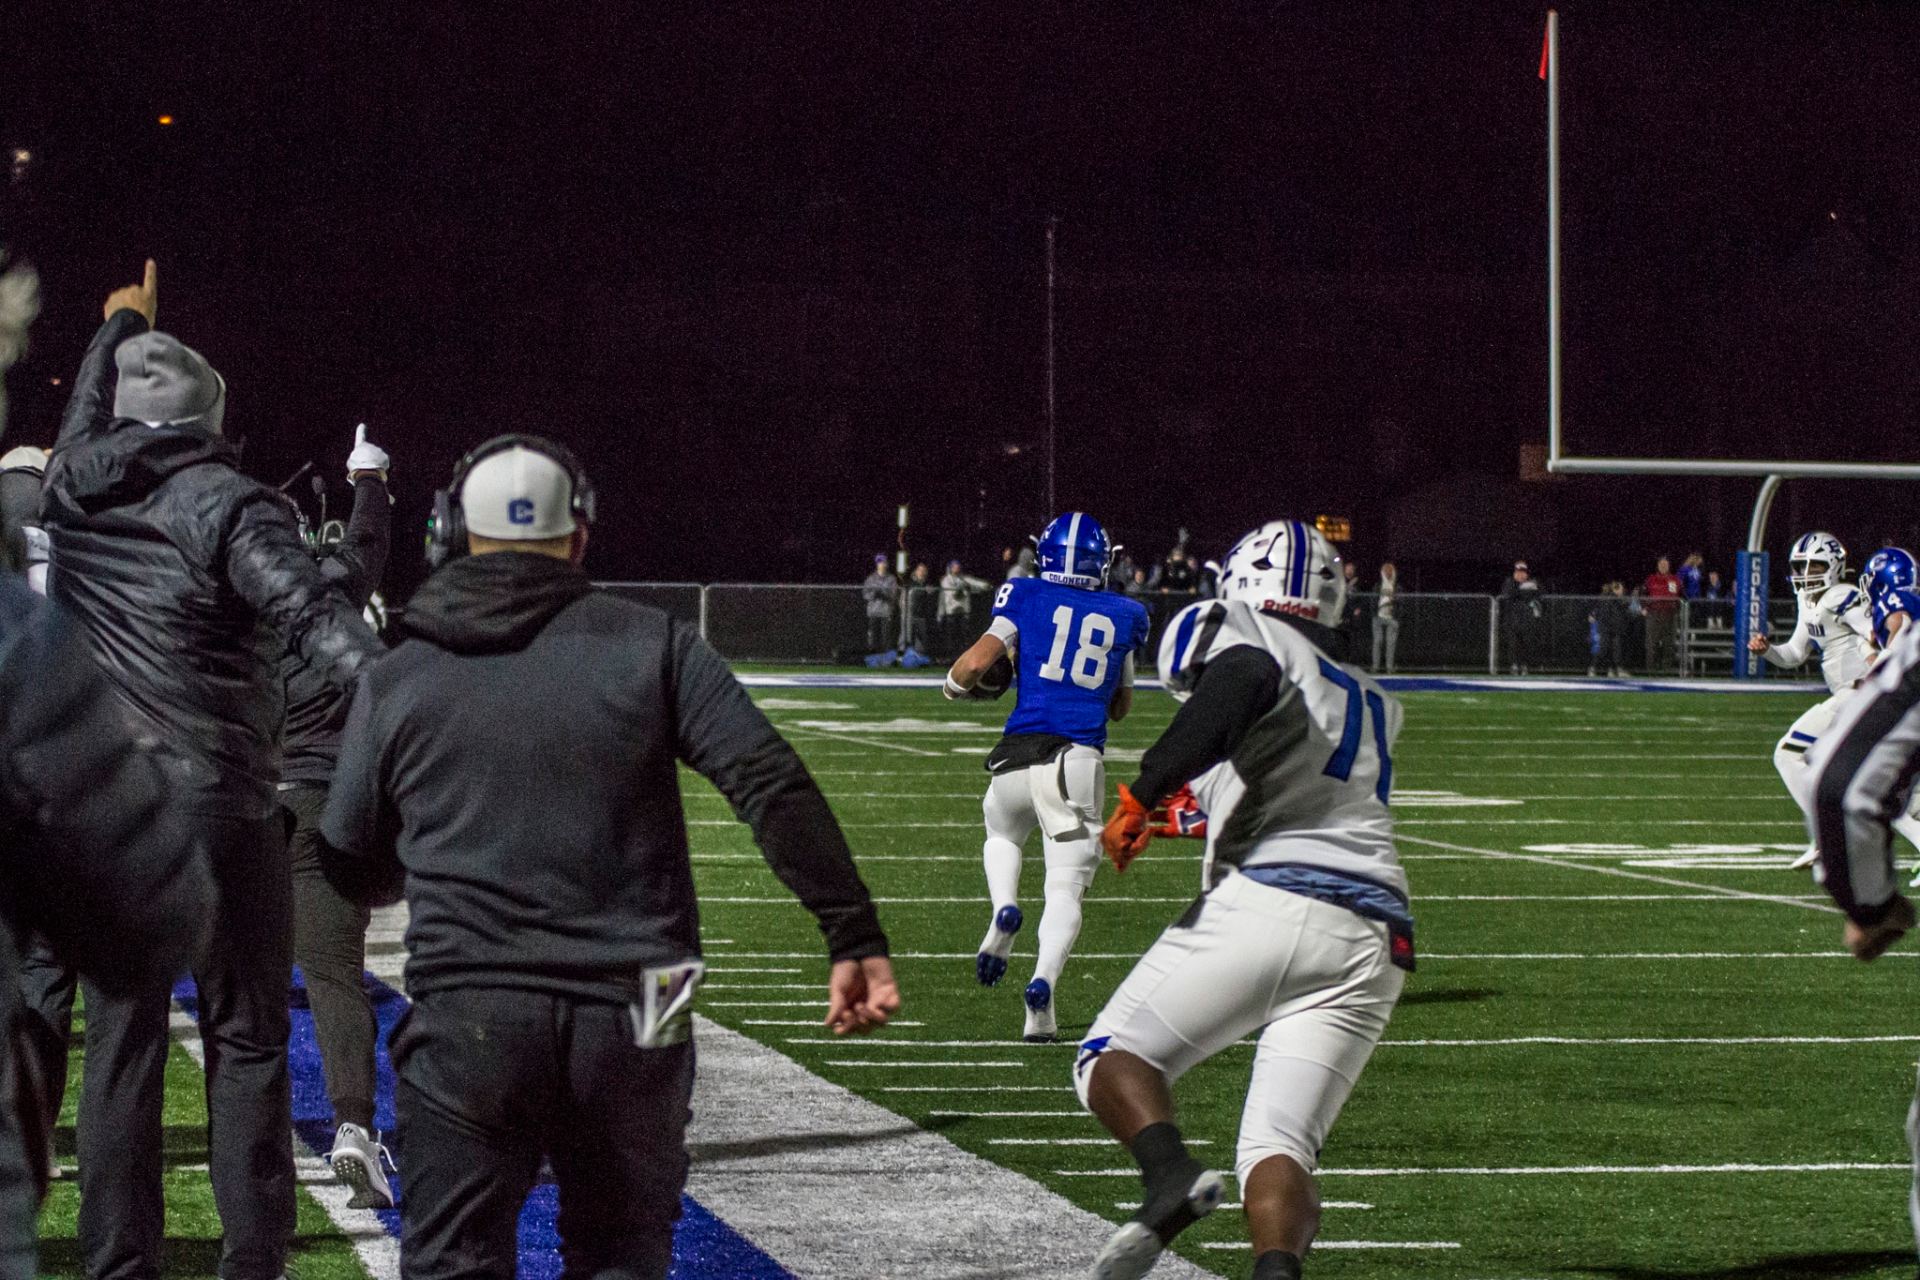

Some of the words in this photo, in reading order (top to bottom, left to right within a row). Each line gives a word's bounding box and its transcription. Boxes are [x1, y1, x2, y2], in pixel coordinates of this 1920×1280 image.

[508, 499, 534, 524] C
[1263, 599, 1319, 619] Riddell
[1748, 556, 1761, 675] COLONLS
[1878, 593, 1903, 616] 14
[1039, 604, 1115, 690] 18
